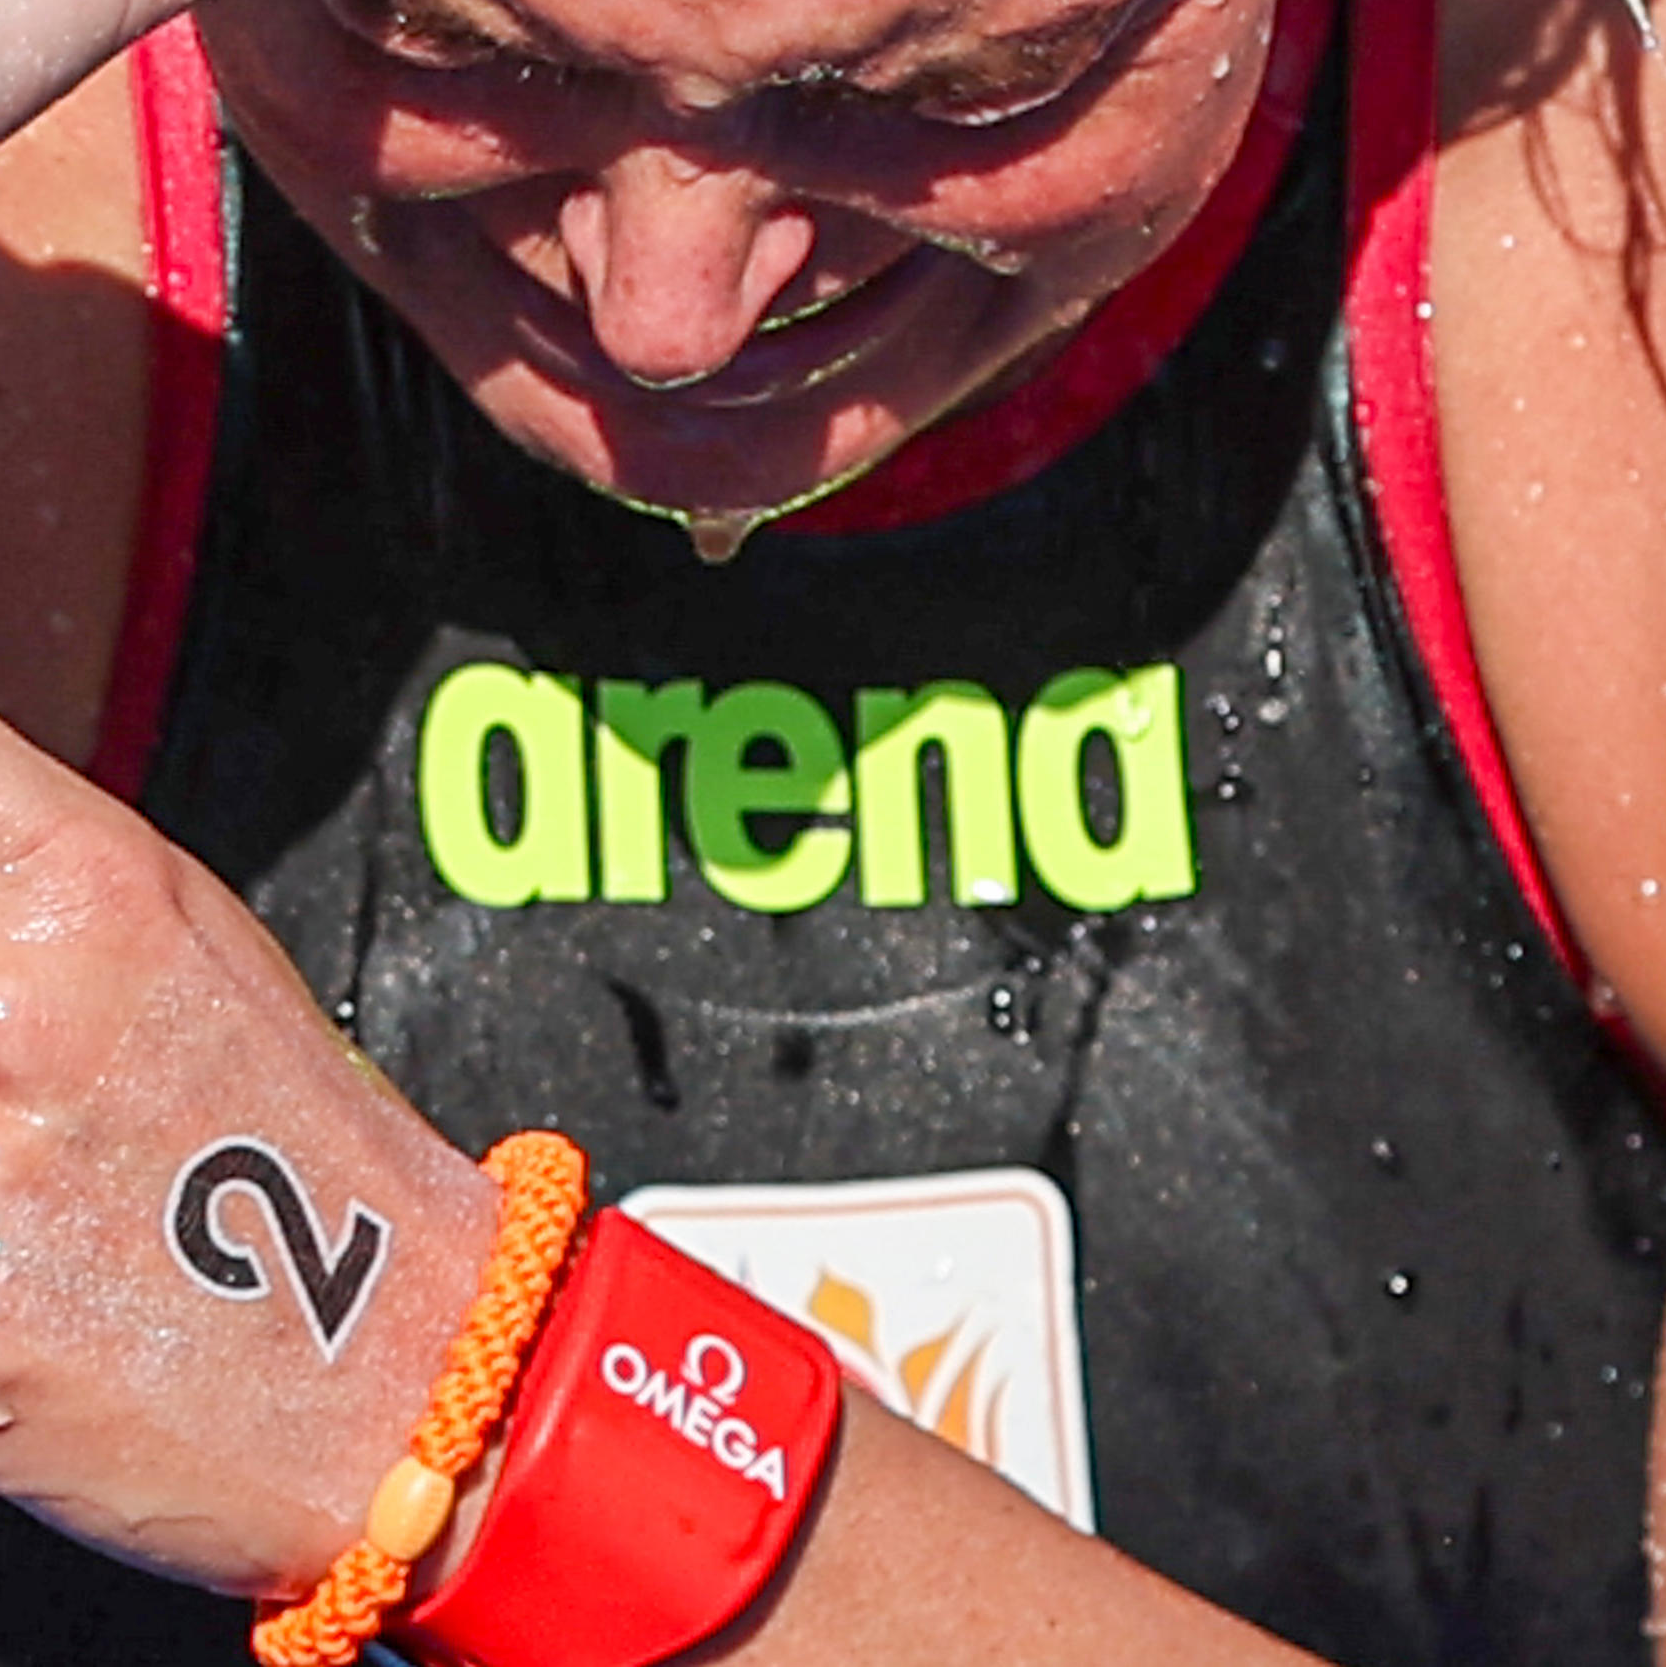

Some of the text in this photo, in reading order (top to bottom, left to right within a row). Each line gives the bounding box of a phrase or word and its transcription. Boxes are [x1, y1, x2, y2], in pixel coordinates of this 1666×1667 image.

[419, 661, 1199, 913] arena
[164, 1134, 391, 1364] 2
[601, 1342, 788, 1501] OMEGA
